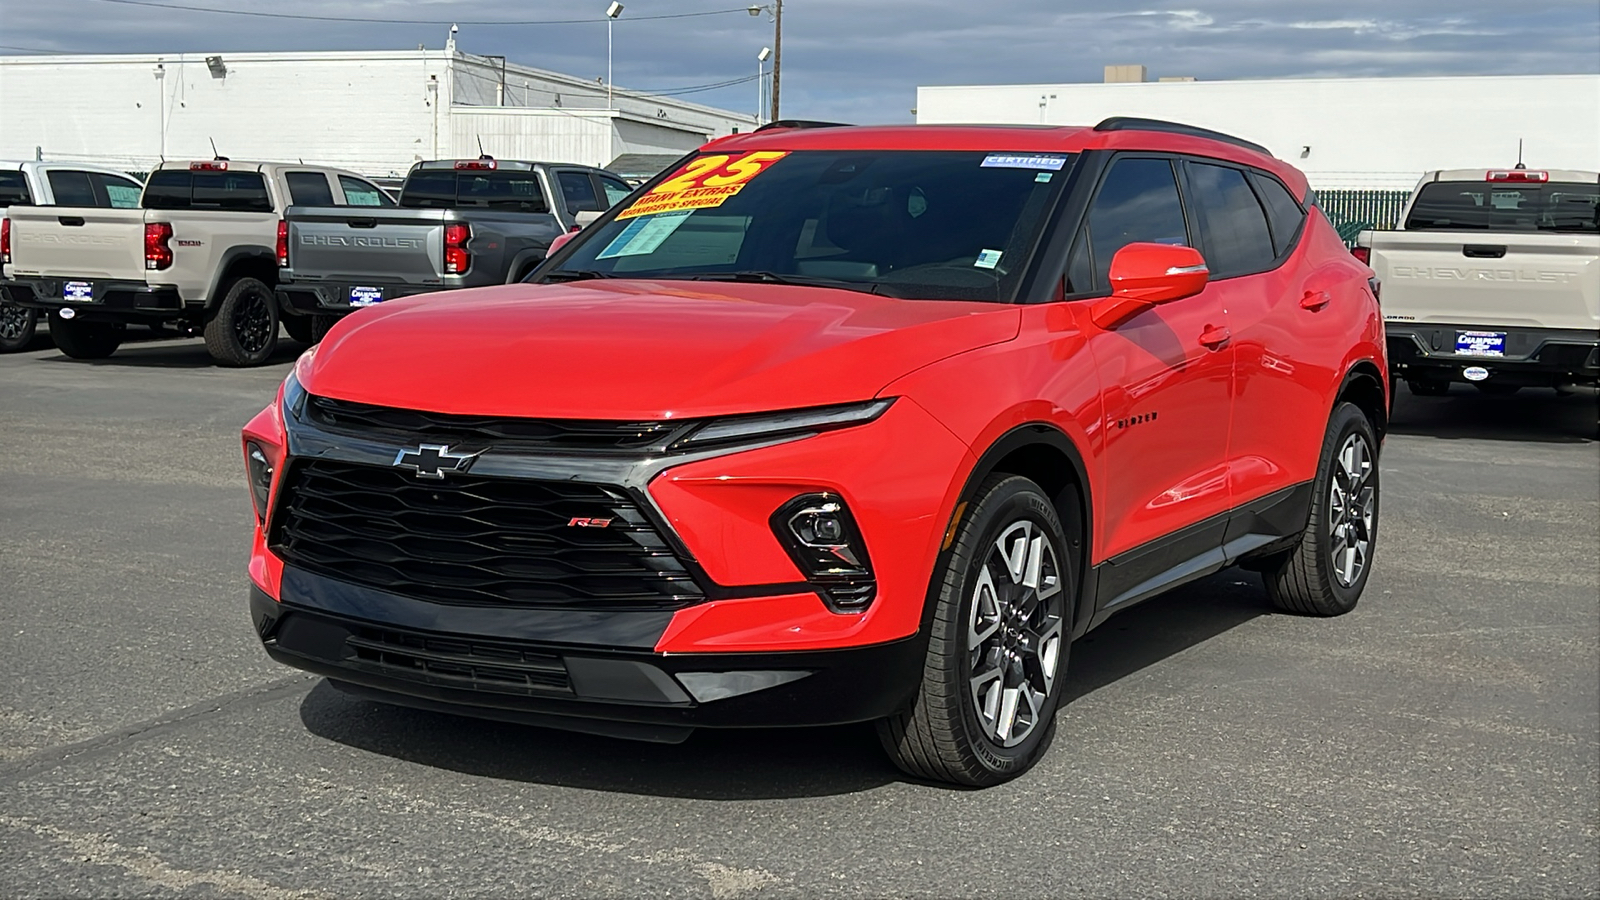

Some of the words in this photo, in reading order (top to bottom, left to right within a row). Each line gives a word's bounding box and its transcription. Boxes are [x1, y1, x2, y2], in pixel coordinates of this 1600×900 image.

[987, 156, 1060, 166] CERTIFIED
[652, 151, 788, 193] 25
[633, 192, 680, 207] MANY
[679, 184, 739, 199] EXTRAS
[620, 201, 680, 218] MANAGER'S
[679, 197, 723, 208] SPECIAL
[21, 232, 126, 245] CHEVROLET
[301, 235, 423, 249] CHEVROLET
[1393, 266, 1577, 283] CHEVROLET
[1457, 334, 1503, 346] CHAMPION
[1117, 412, 1158, 429] BLAZER
[567, 517, 612, 528] RS
[976, 741, 1012, 770] MICHELIN
